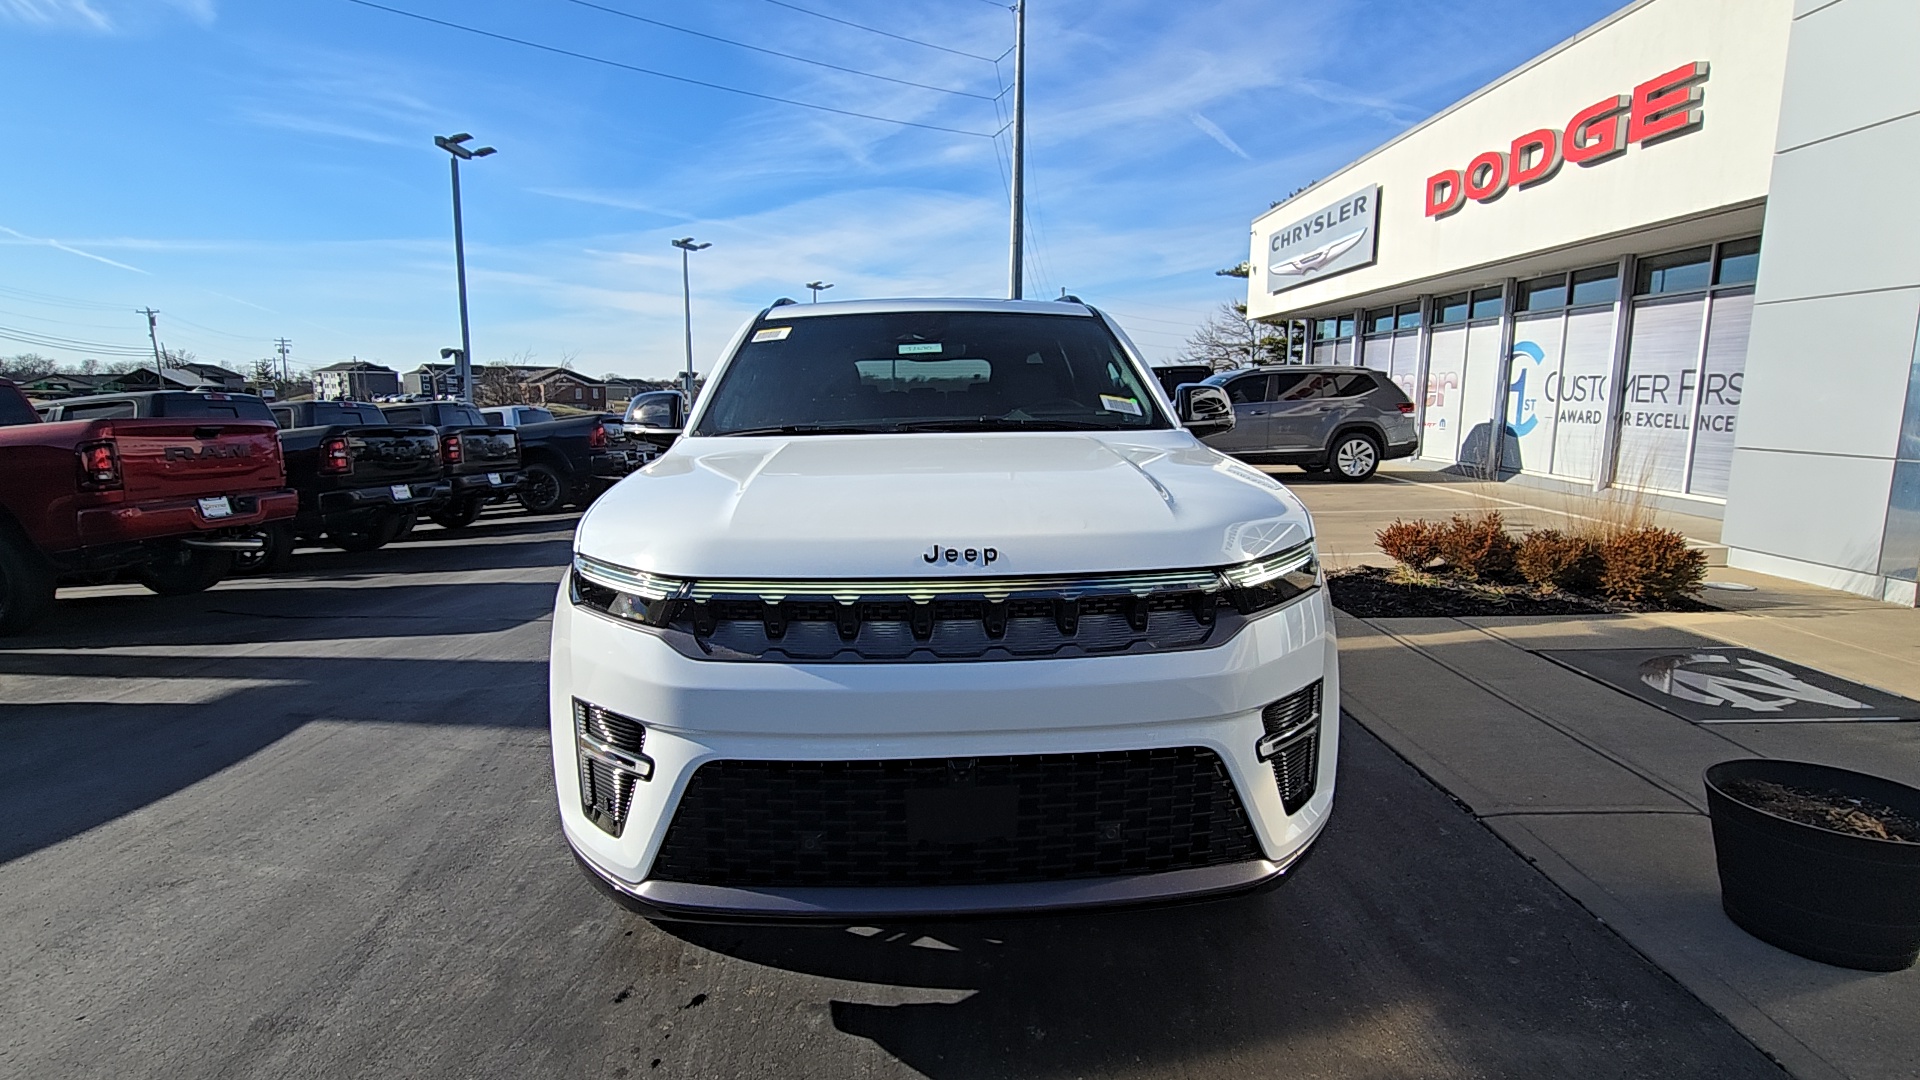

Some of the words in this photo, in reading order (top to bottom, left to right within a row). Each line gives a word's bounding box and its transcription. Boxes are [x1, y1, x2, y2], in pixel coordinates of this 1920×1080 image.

[1425, 60, 1704, 217] DODGE
[1271, 195, 1368, 252] CHRYSLER
[1677, 369, 1745, 405] FIRS
[1558, 409, 1602, 424] AWARD
[1635, 412, 1736, 432] EXCELLNCE
[163, 444, 251, 462] RAM
[922, 544, 999, 567] Jeep
